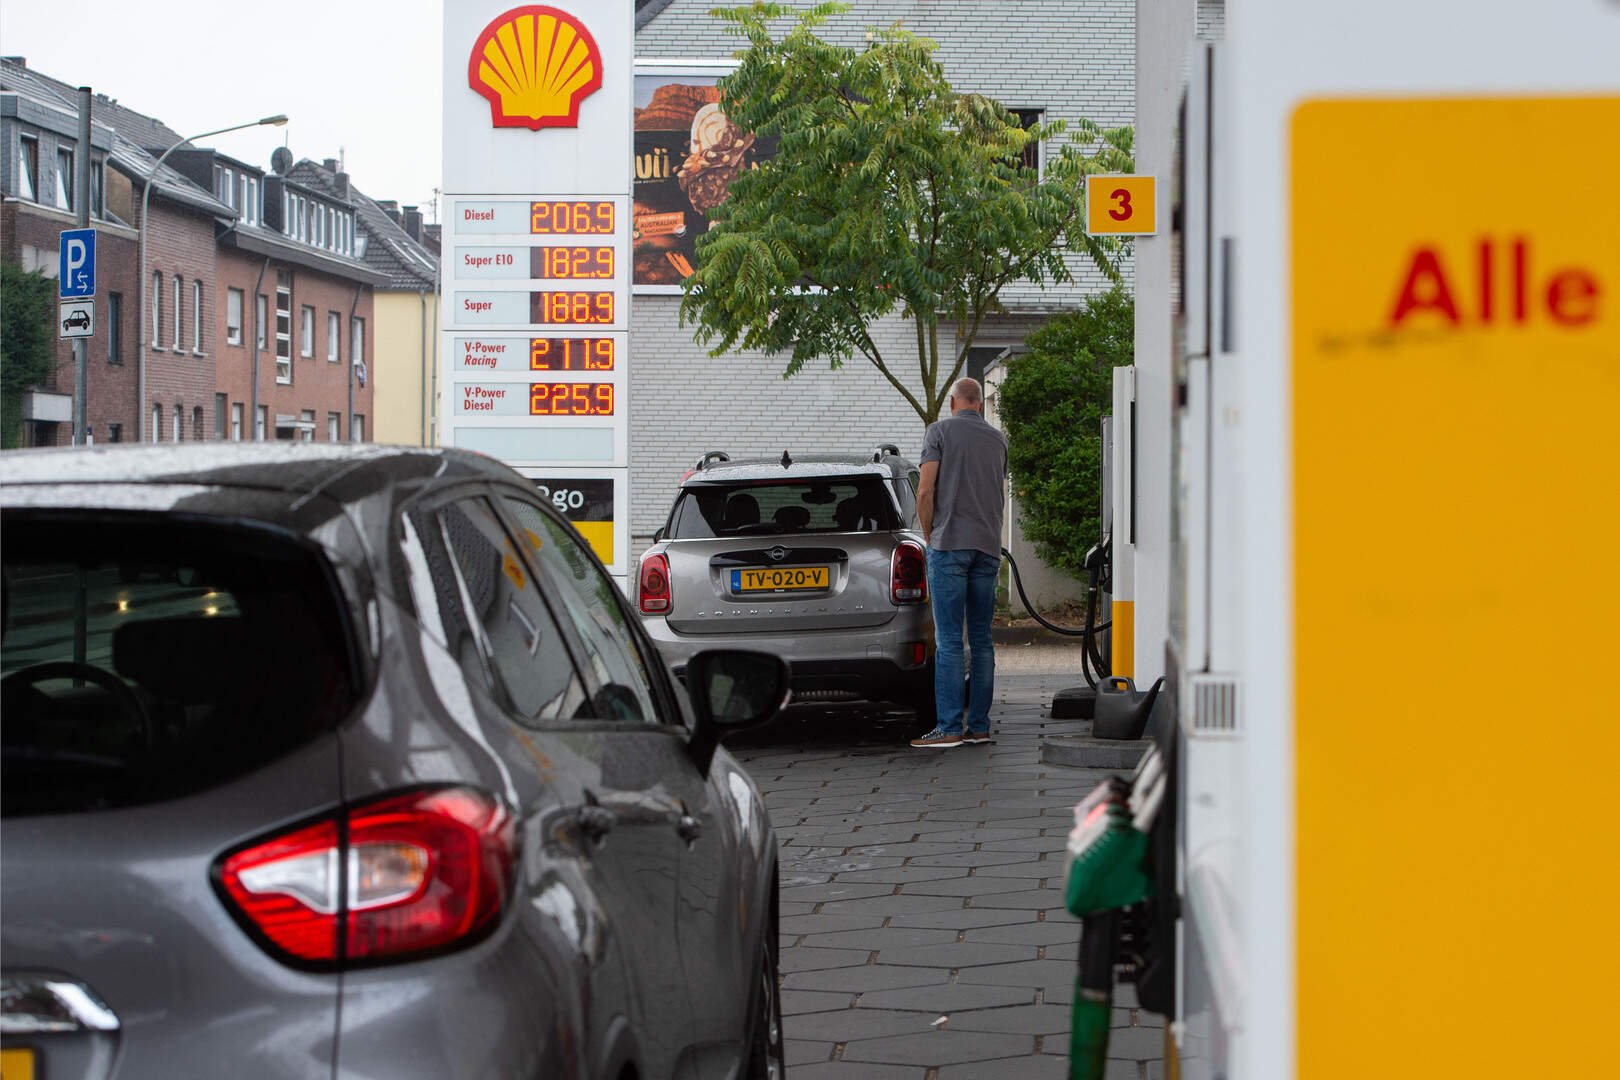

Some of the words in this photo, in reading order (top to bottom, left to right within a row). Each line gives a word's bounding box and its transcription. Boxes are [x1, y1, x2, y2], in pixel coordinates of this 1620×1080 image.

[633, 147, 670, 179] uii
[464, 208, 494, 220] Diesel
[532, 202, 614, 233] 206.9
[1108, 188, 1133, 221] 3
[67, 239, 87, 289] P
[464, 254, 492, 268] Super
[496, 254, 513, 265] E10
[543, 247, 614, 278] 182.9
[1389, 234, 1601, 330] Alle
[464, 299, 492, 313] Super
[542, 292, 613, 323] 188.9
[464, 342, 506, 353] V-Power
[464, 354, 497, 369] Racing
[531, 338, 613, 369] 211.9
[464, 387, 506, 398] V-Power
[464, 398, 494, 410] Diesel
[531, 384, 613, 415] 225.9
[746, 570, 822, 587] TV-020-V
